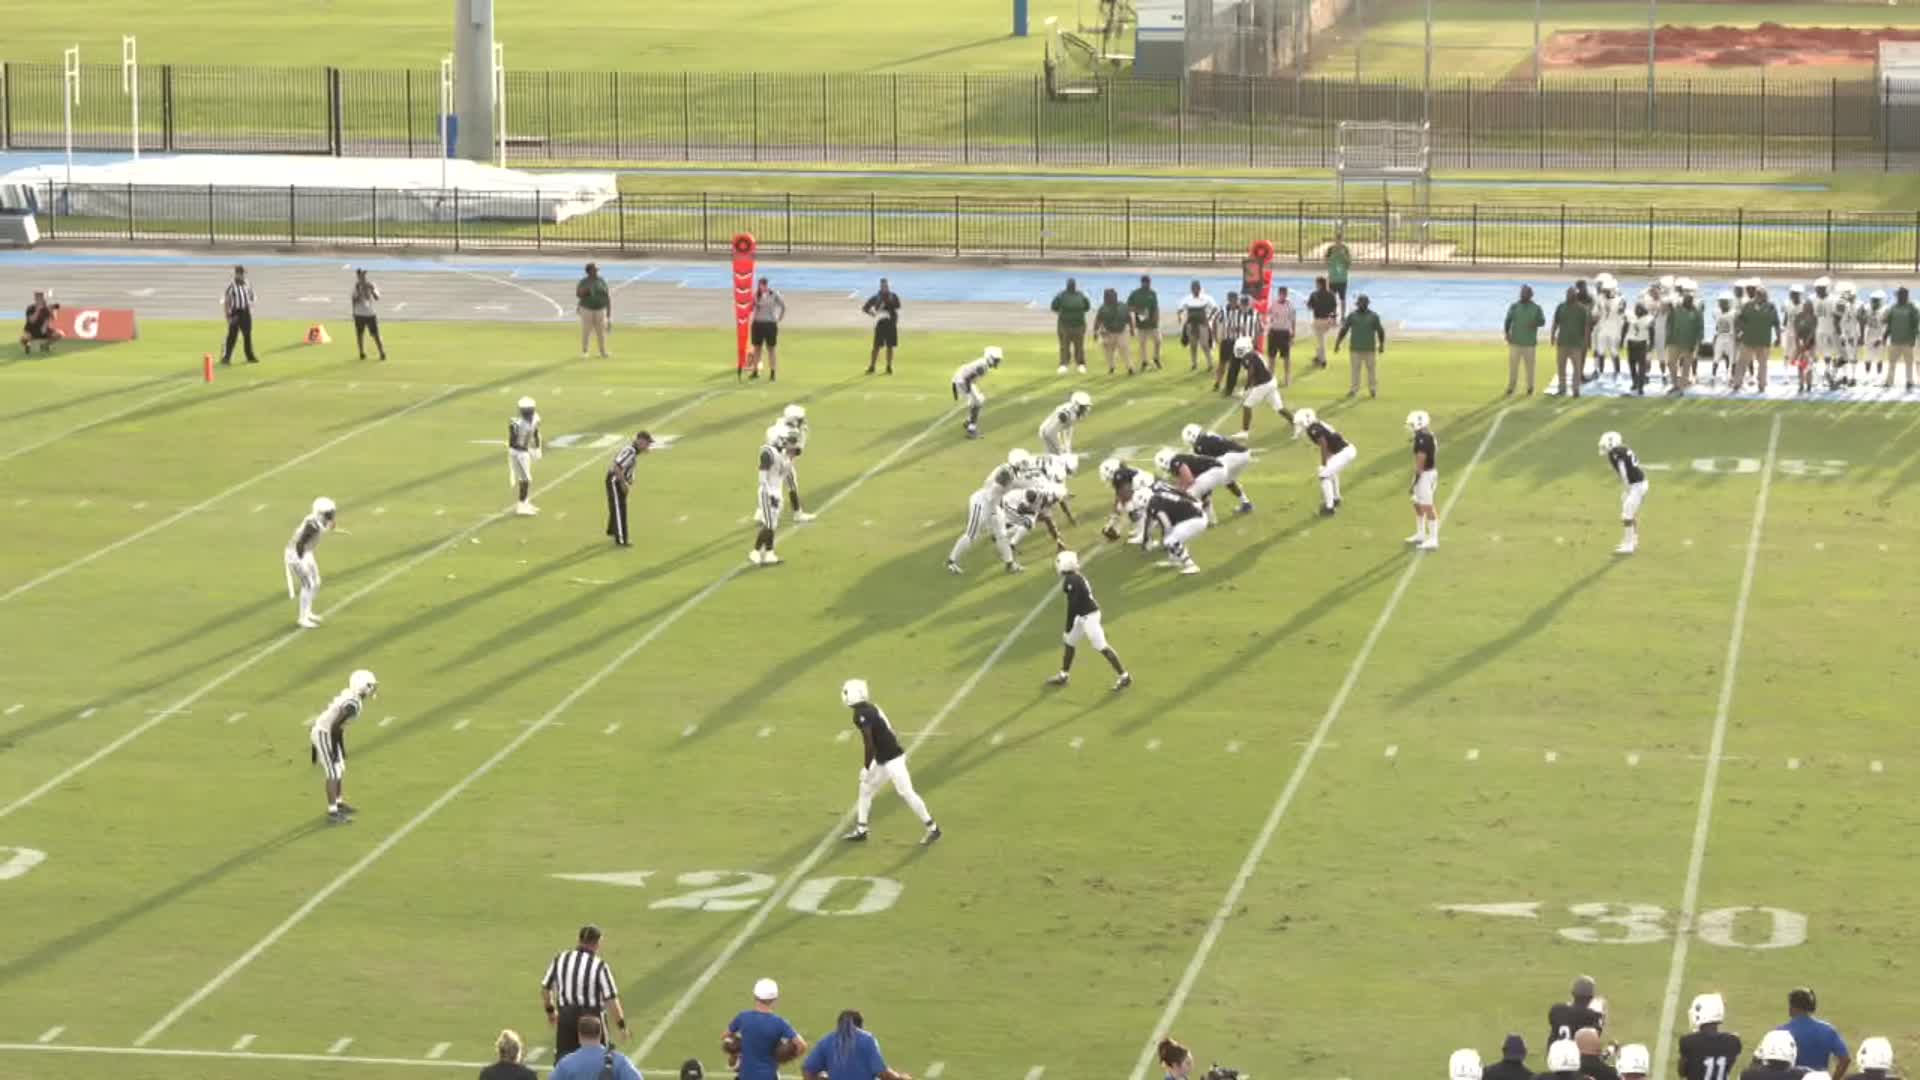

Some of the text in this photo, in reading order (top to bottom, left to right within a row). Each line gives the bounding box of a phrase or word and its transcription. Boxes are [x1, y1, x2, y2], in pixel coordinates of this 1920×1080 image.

[74, 311, 99, 338] G
[647, 870, 904, 915] 20
[1557, 902, 1808, 948] 30
[1703, 1055, 1727, 1080] 11
